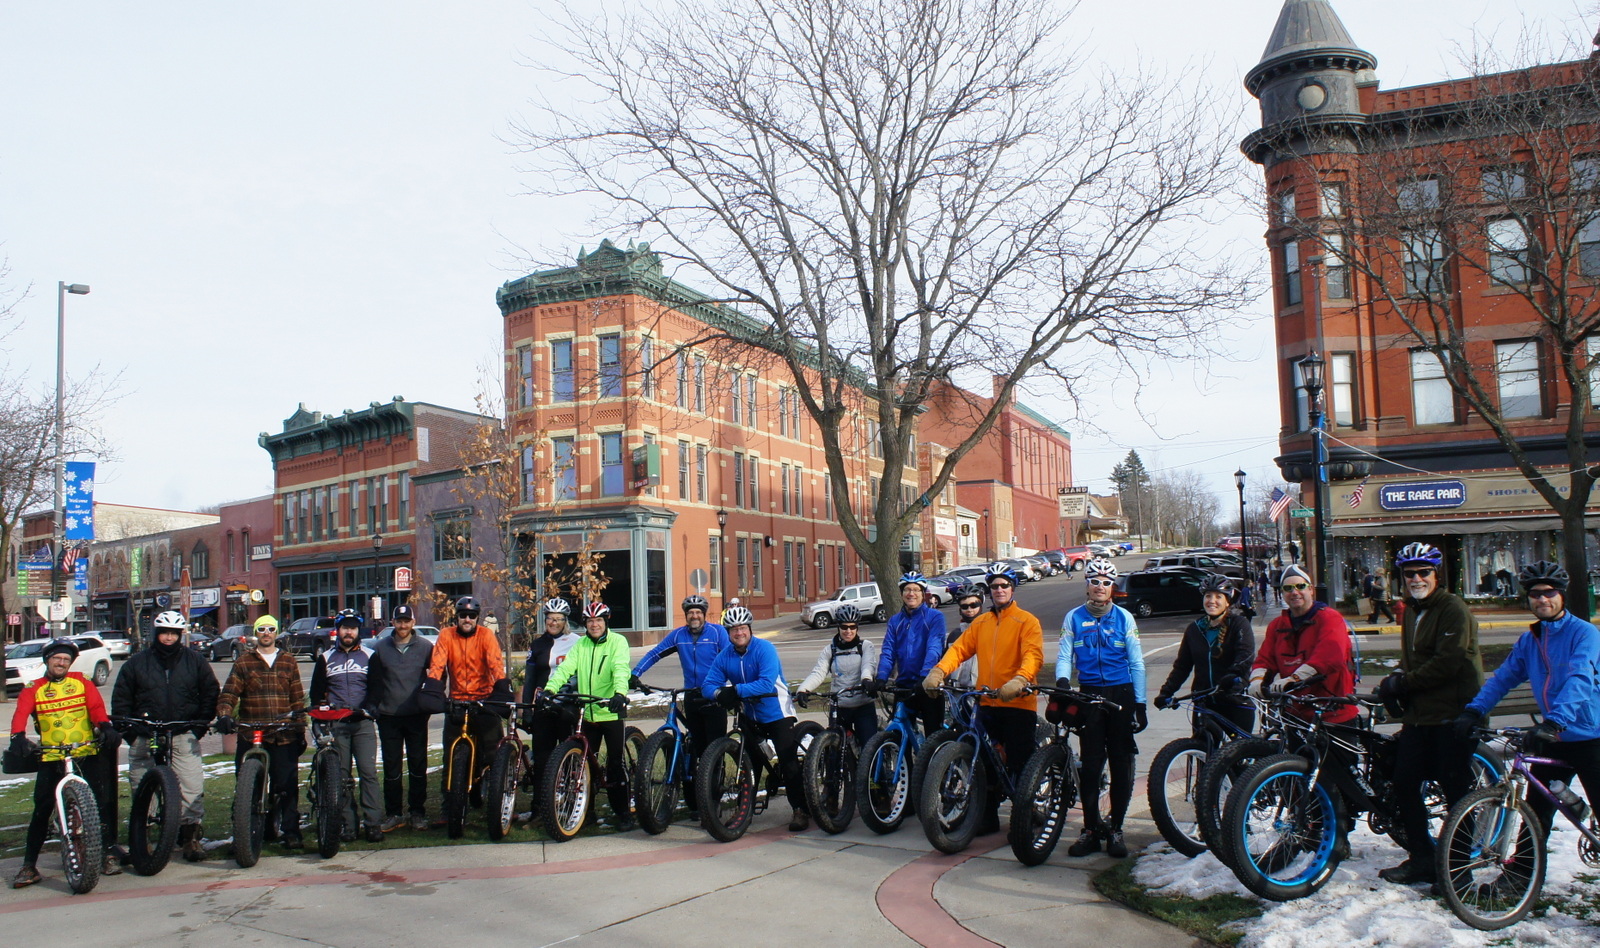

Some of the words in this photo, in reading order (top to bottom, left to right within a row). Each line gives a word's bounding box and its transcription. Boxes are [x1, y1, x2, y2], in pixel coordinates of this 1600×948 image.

[1386, 491, 1406, 502] THE
[1408, 489, 1435, 501] RARE
[1437, 488, 1461, 500] PAIR
[252, 545, 271, 555] TINY'S
[398, 571, 409, 579] 24
[38, 697, 86, 711] LEMOND
